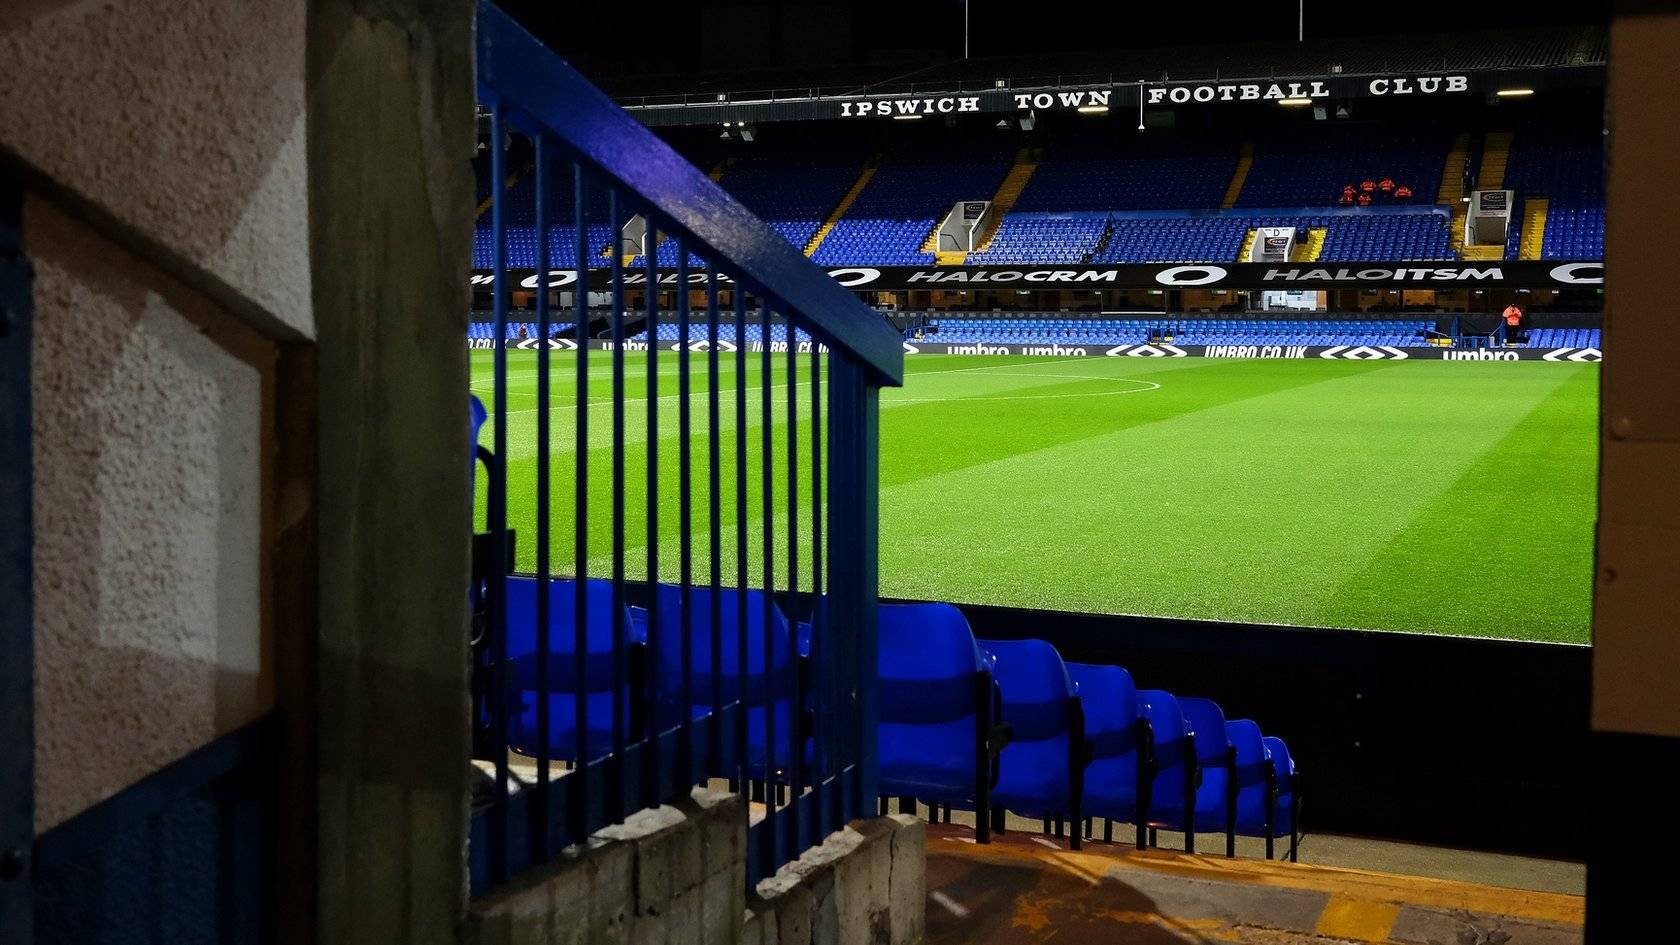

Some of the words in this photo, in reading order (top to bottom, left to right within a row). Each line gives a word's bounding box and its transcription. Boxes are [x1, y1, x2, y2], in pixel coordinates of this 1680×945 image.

[841, 97, 980, 116] IPSWICH
[1014, 90, 1112, 109] TOWN
[1148, 82, 1330, 103] FOOTBALL
[1369, 76, 1468, 95] CLUB
[1273, 228, 1280, 236] D
[907, 270, 1118, 282] HALOCRM
[1263, 268, 1504, 281] HALOITSM
[947, 343, 1010, 356] umbro
[1022, 344, 1087, 356] umbro
[1204, 345, 1308, 359] UMBRO.CO.UK
[1442, 347, 1520, 361] umbro
